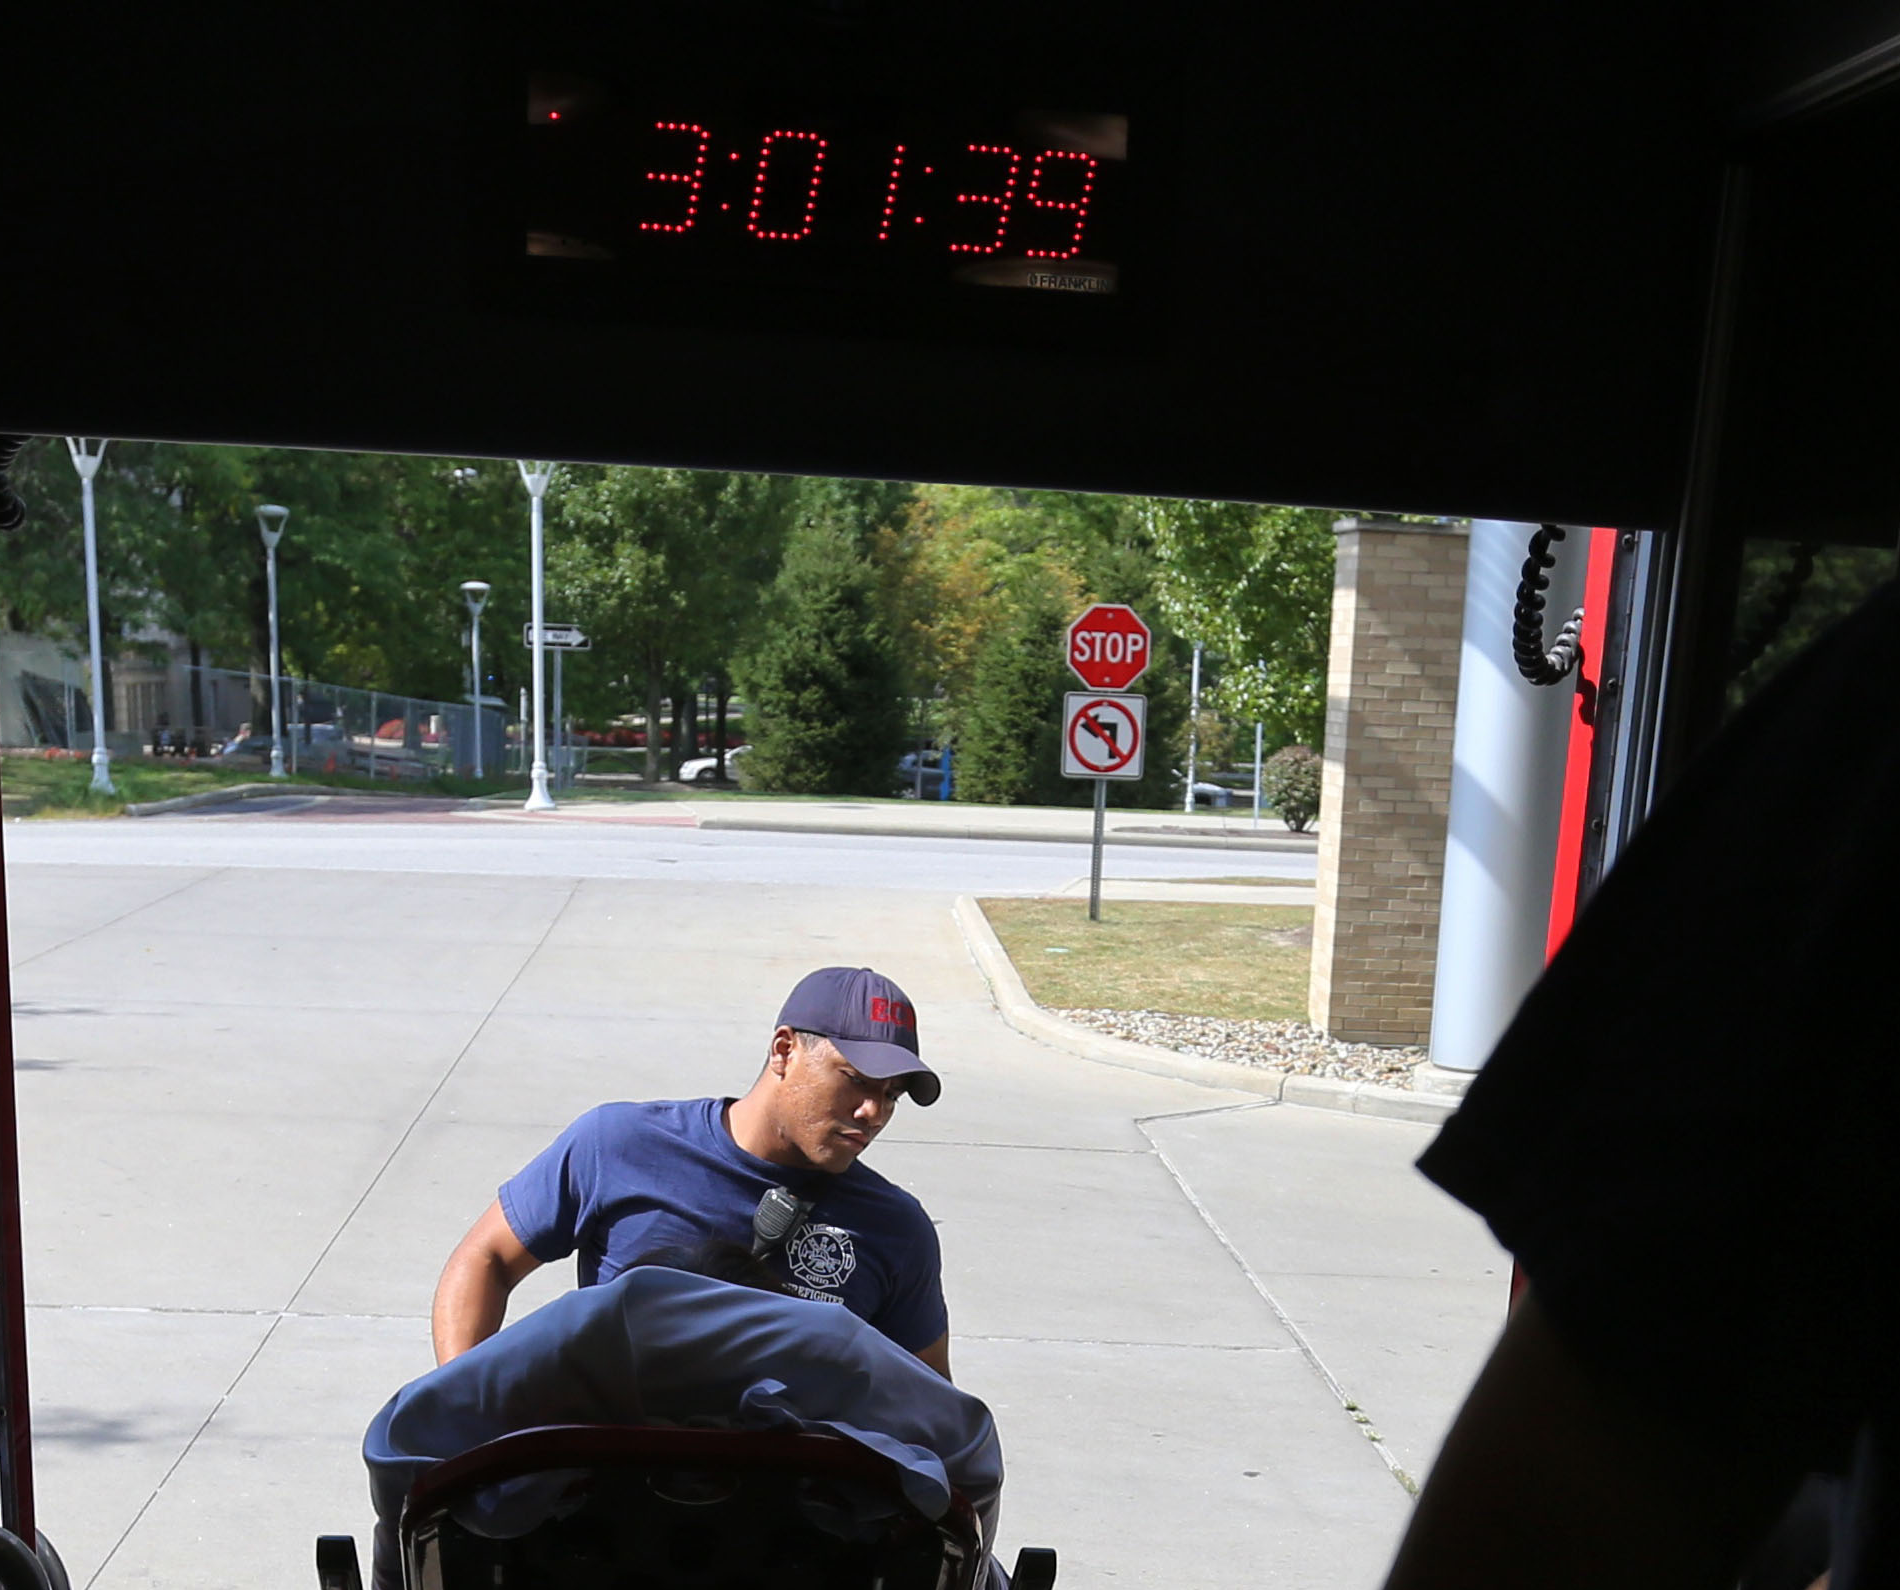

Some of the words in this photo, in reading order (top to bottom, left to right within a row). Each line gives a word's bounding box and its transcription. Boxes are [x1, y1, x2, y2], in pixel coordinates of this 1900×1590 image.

[635, 118, 1098, 260] 3:01:39
[1039, 274, 1109, 292] FRANKLIN
[1073, 630, 1145, 664] STOP
[806, 1274, 829, 1286] OHIO
